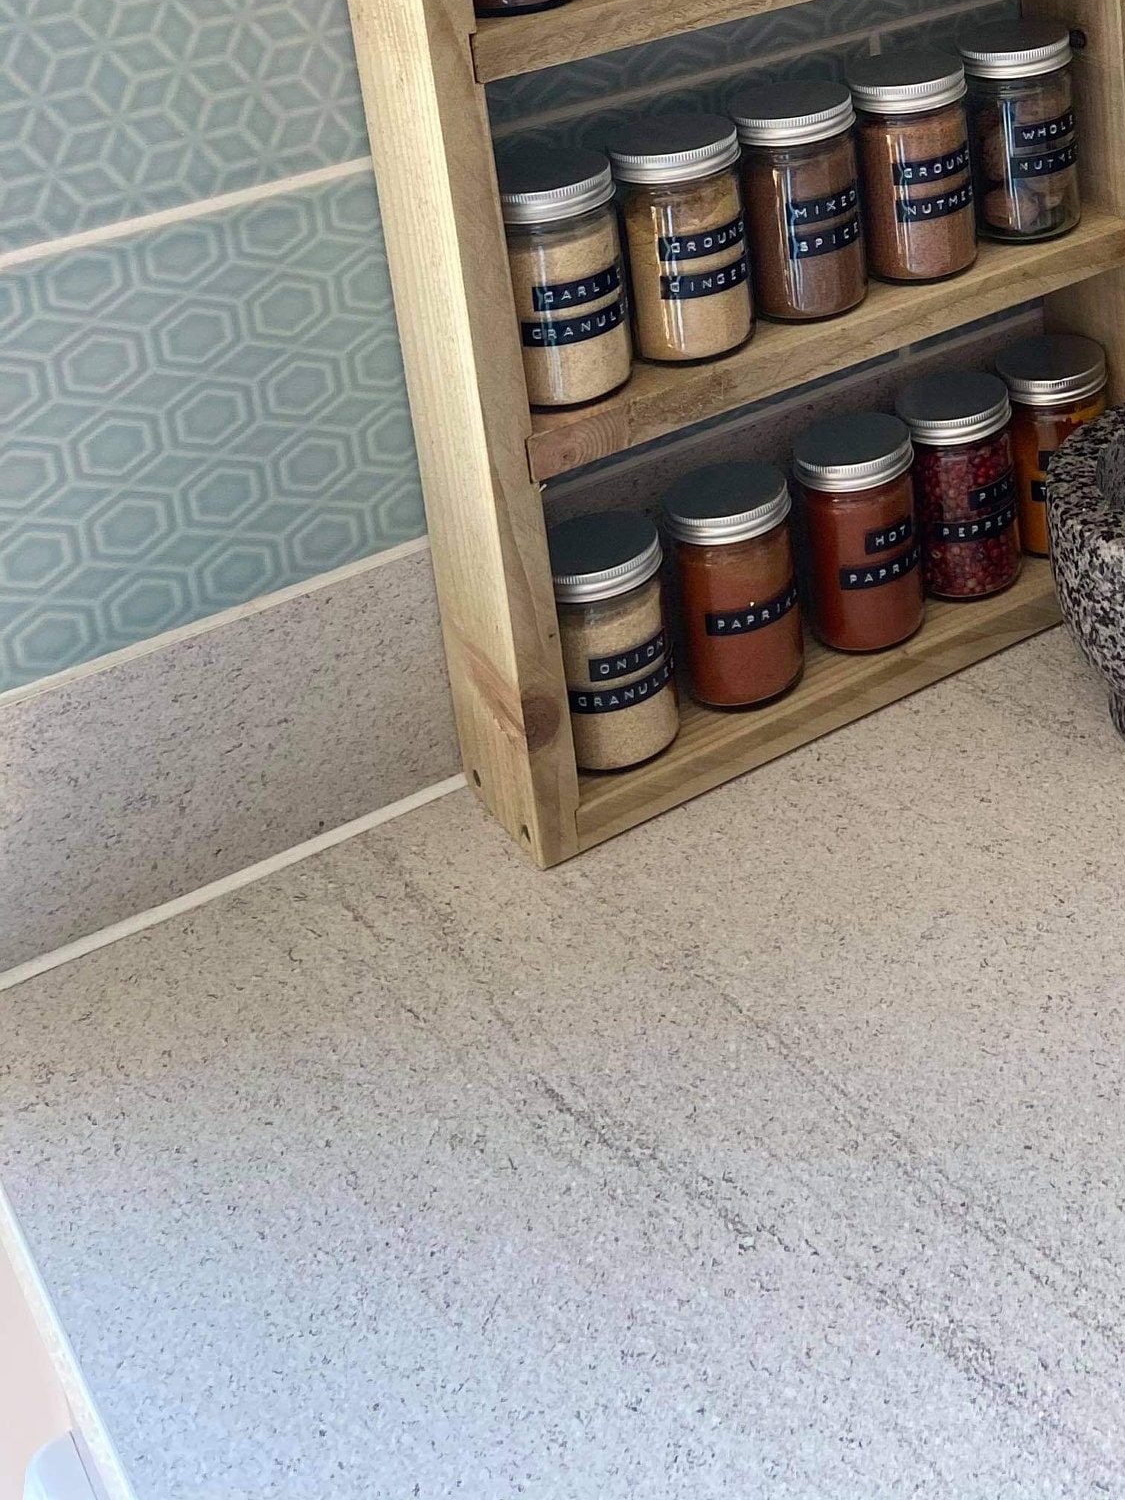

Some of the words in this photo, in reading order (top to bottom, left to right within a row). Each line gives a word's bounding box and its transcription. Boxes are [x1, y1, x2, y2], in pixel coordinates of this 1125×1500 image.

[793, 189, 856, 219] MIXED
[669, 220, 745, 254] GROUND
[798, 221, 859, 253] SPICE
[669, 262, 746, 293] GINGER
[875, 524, 907, 547] HOT
[599, 636, 664, 675] ONION
